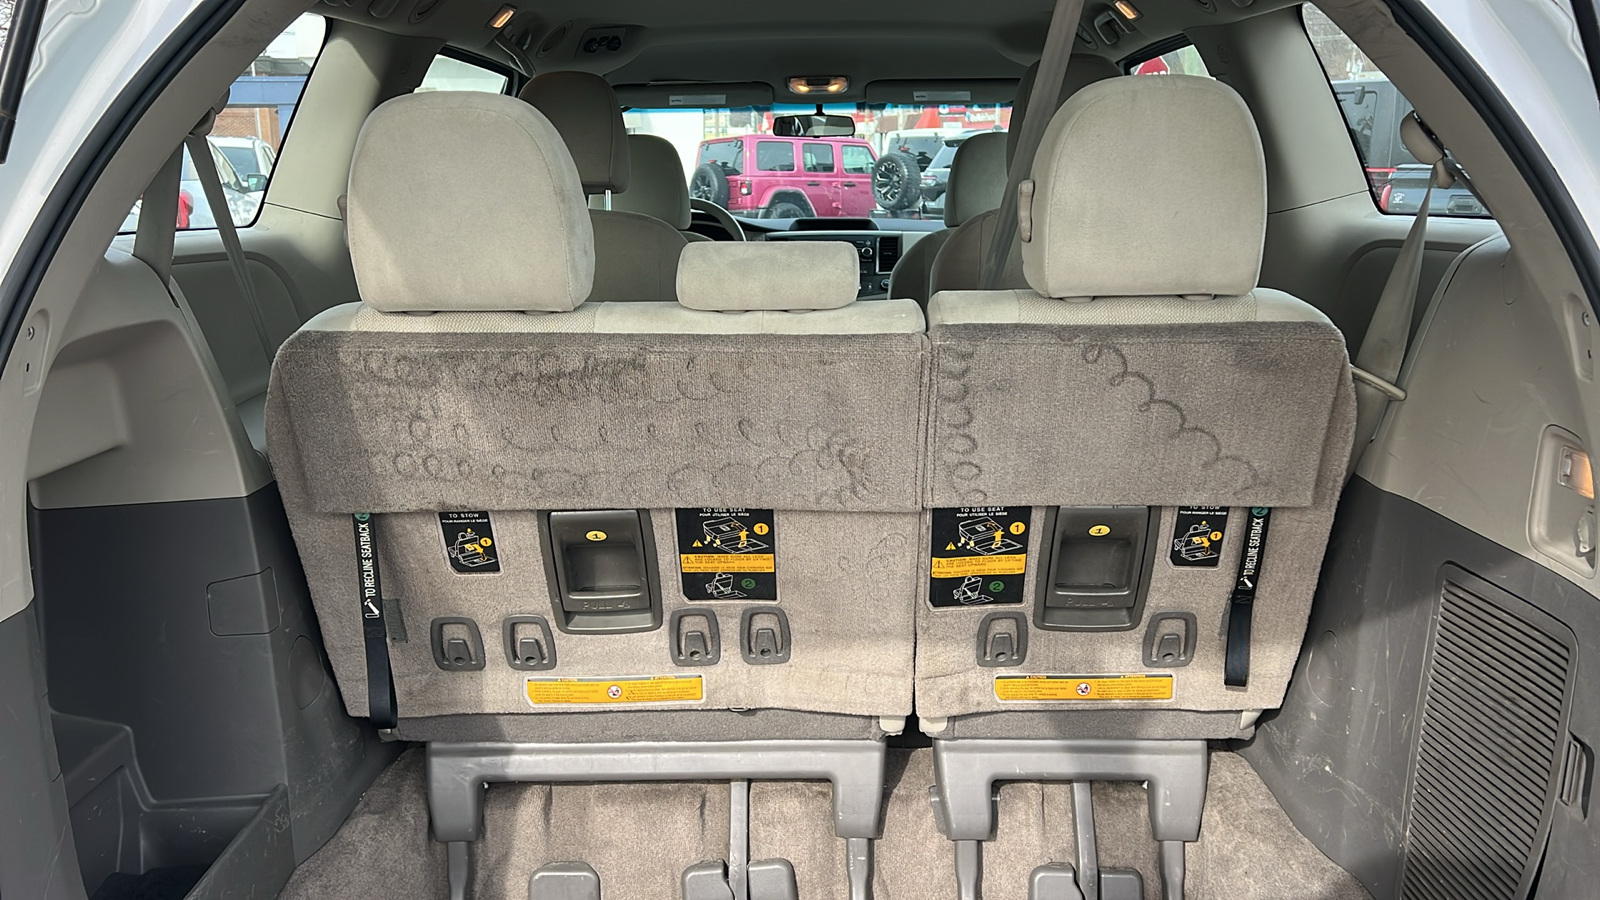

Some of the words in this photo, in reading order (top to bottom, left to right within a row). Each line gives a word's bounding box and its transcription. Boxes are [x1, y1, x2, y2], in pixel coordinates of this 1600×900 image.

[358, 522, 373, 558] SEATBACK
[1248, 517, 1265, 547] SEATBACK
[1244, 547, 1259, 569] RECLINE
[362, 559, 375, 588] RECLINE
[364, 588, 376, 598] TO
